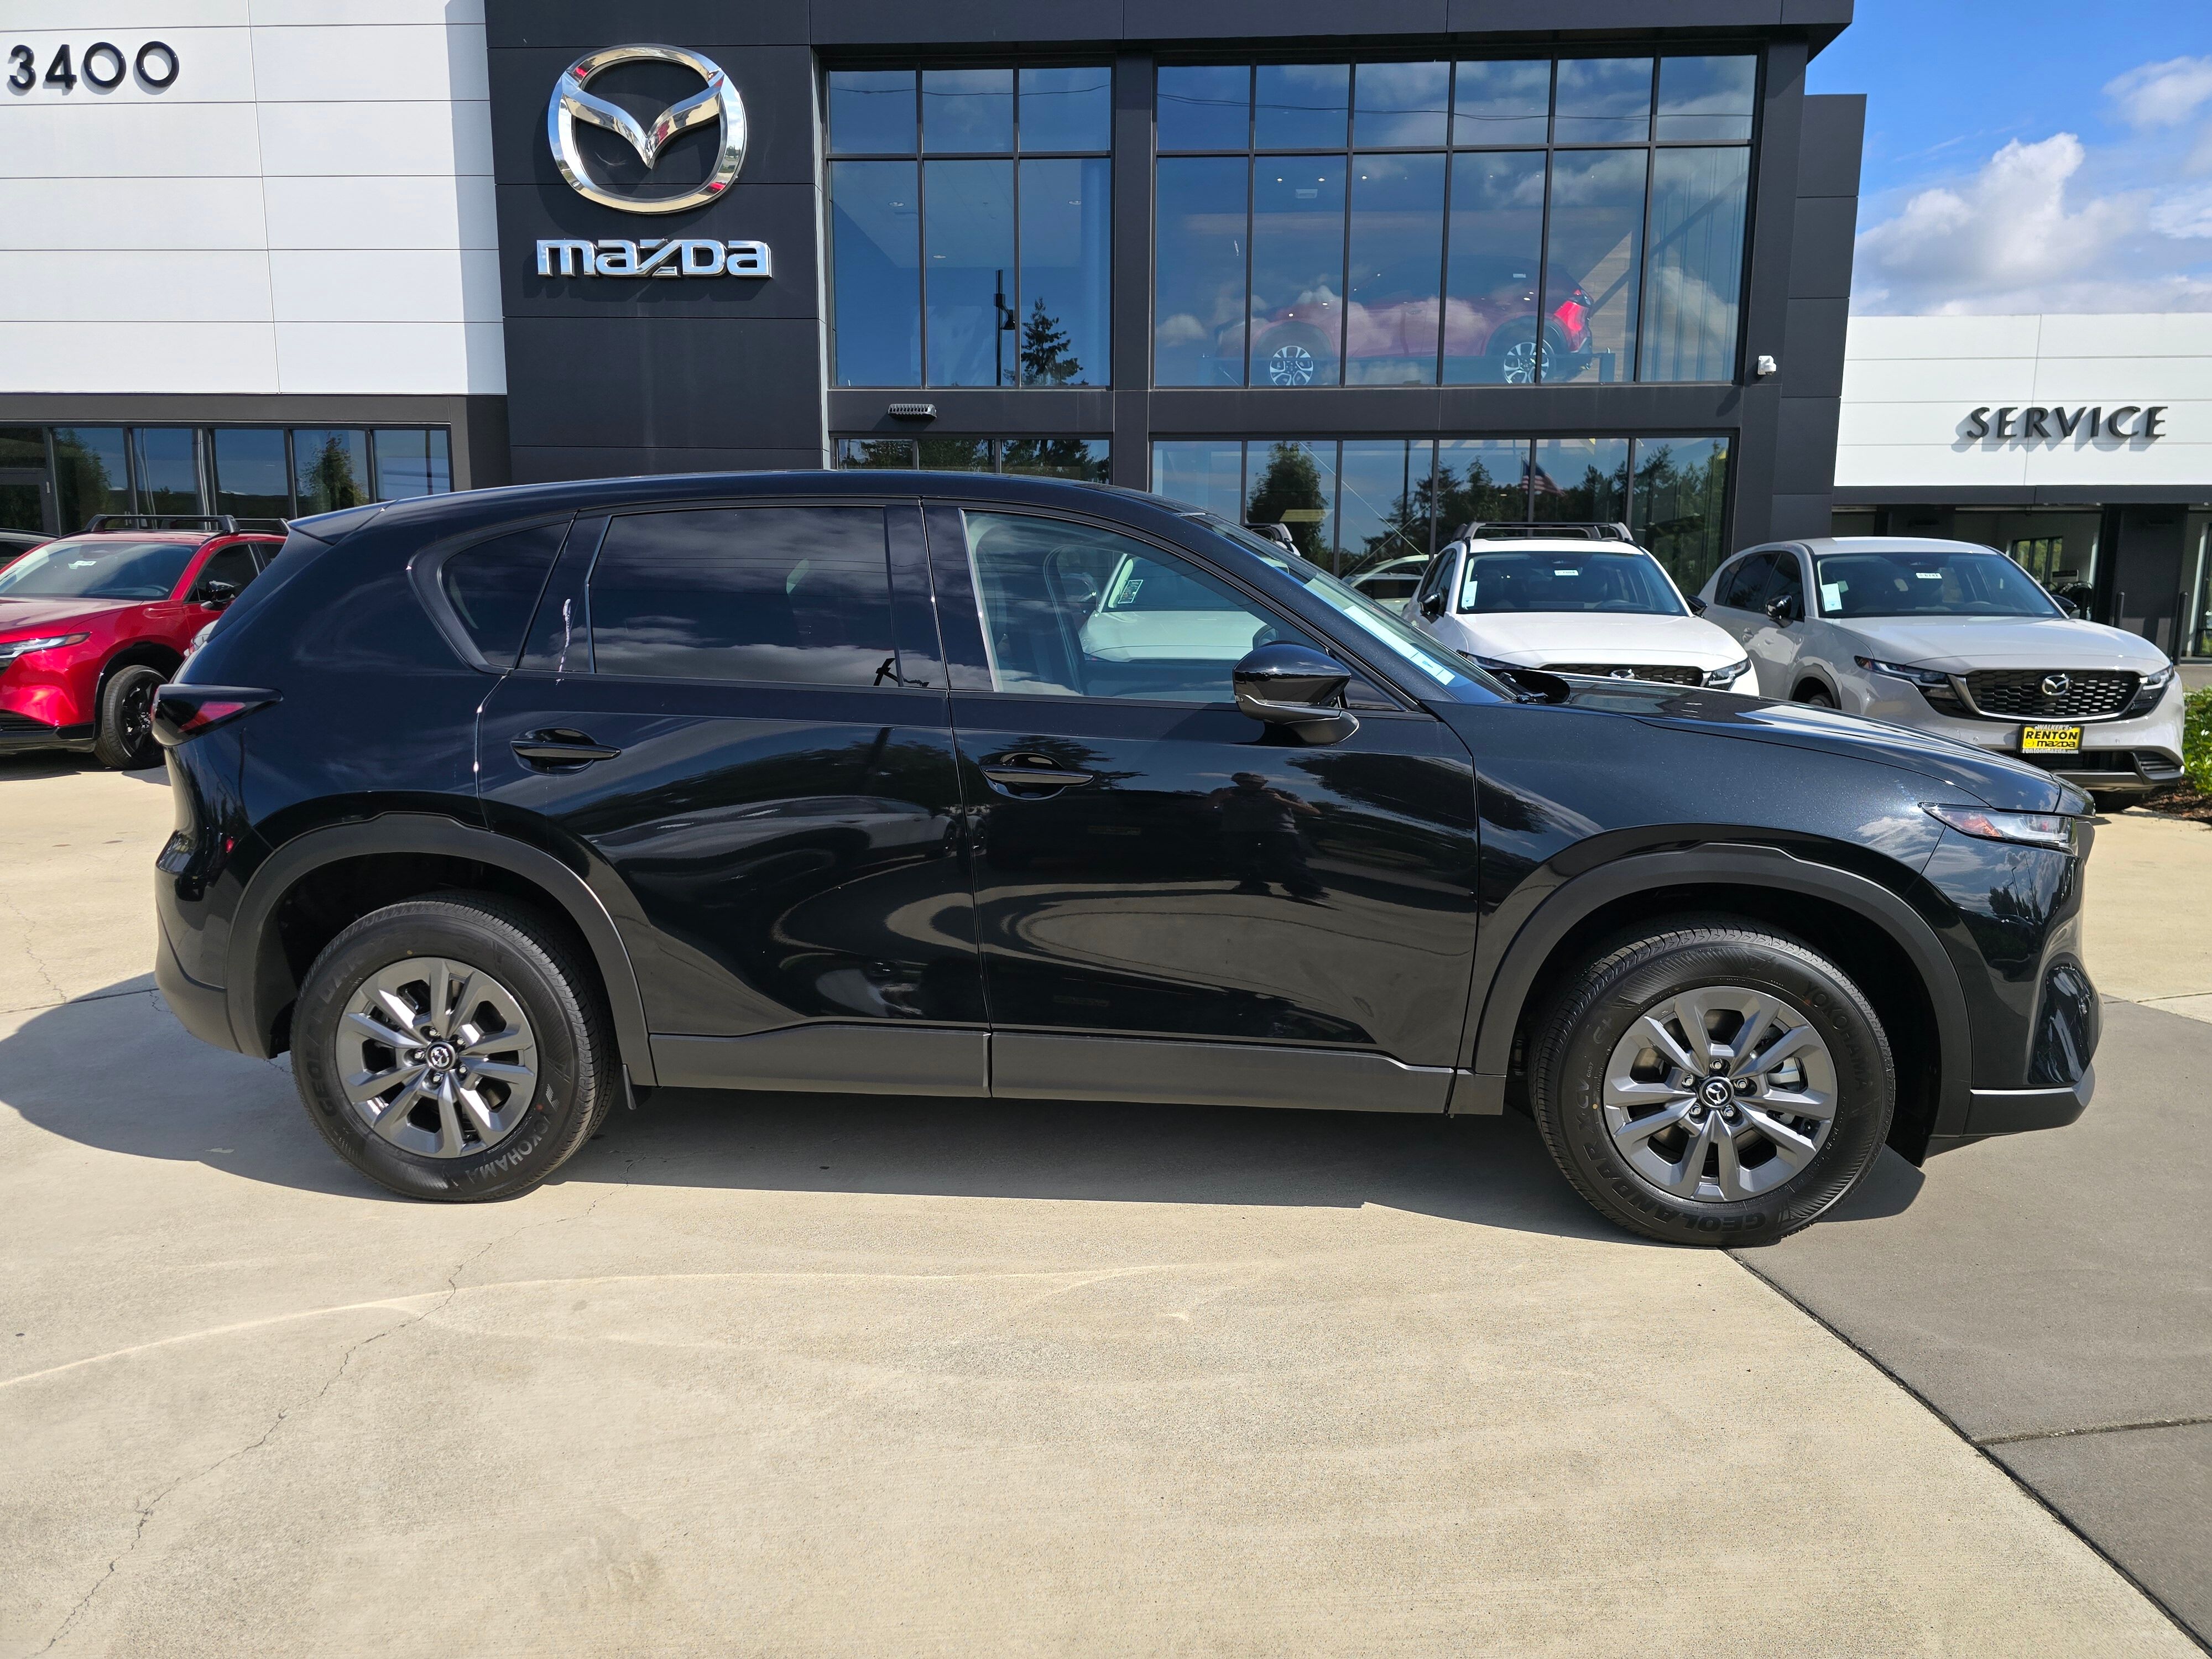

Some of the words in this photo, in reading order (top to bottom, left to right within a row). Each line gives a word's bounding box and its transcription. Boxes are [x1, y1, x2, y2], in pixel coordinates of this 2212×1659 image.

[9, 41, 180, 90] 3400
[1966, 406, 2168, 439] SERVICE
[2025, 731, 2078, 740] RENTON
[1802, 980, 1869, 1091] YOKOHAMA
[465, 1110, 552, 1184] YOKOHAMA
[1582, 1141, 1767, 1233] GEOLANDAR
